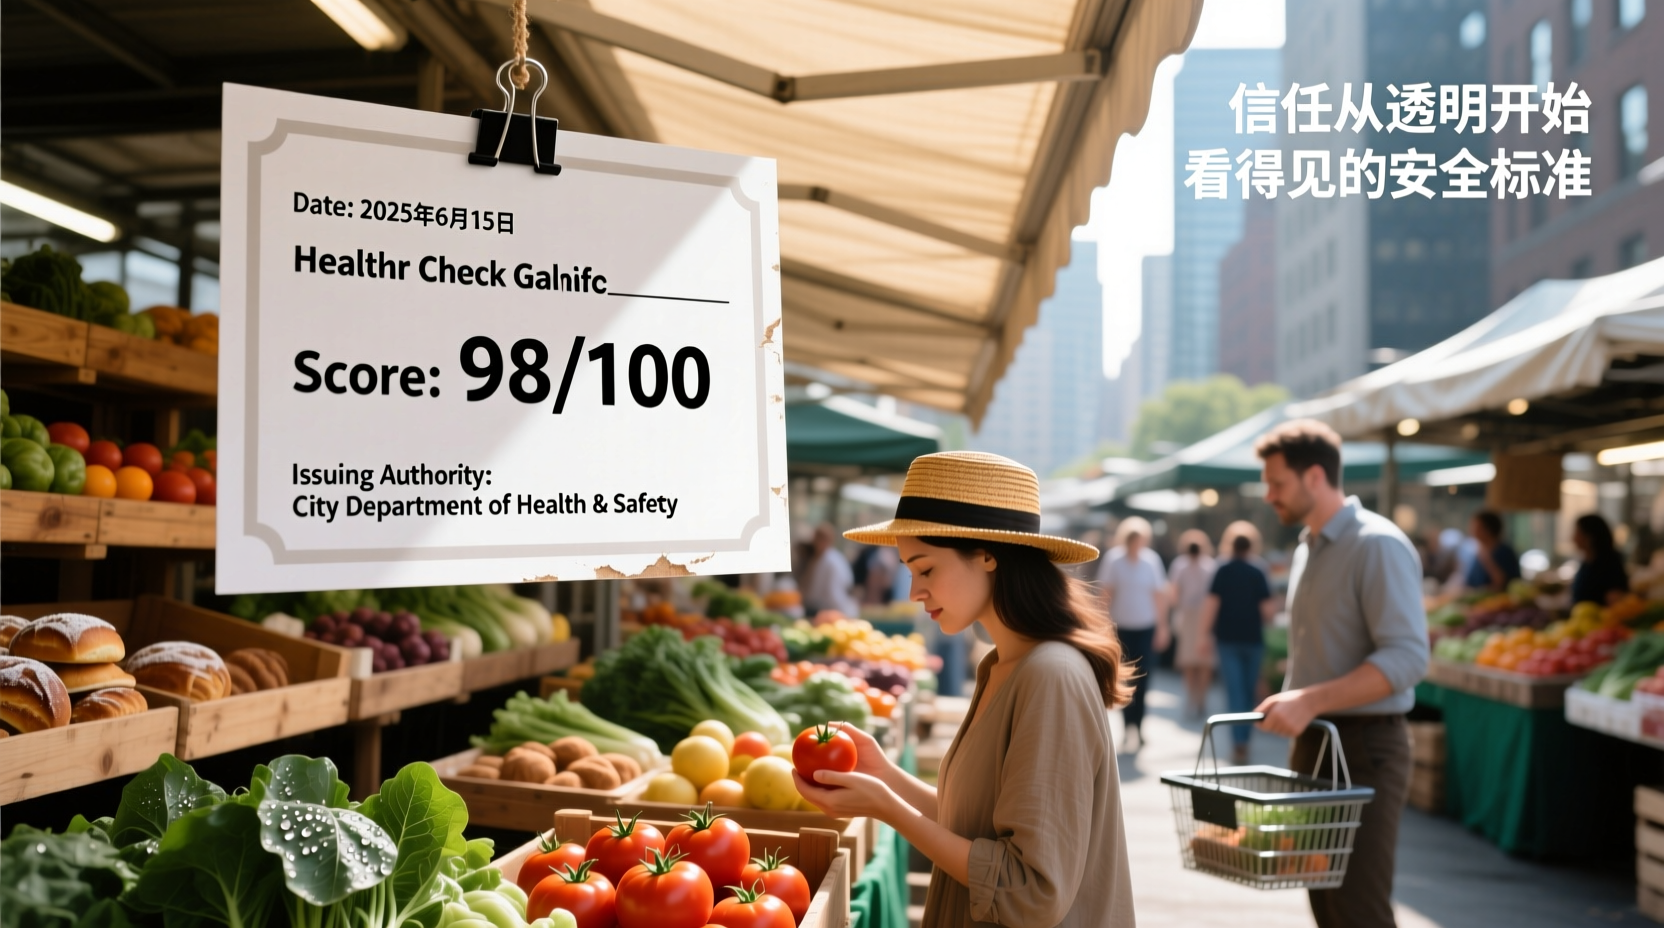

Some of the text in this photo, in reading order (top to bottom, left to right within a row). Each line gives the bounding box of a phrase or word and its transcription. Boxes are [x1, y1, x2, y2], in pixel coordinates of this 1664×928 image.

[293, 191, 515, 235] Date: 2025年6月15日
[294, 245, 411, 281] Healthr
[418, 255, 507, 288] Check
[293, 335, 711, 415] Score: 98/100
[292, 463, 492, 492] Issuing Authority:
[292, 492, 678, 521] City Department of Health & Safety
